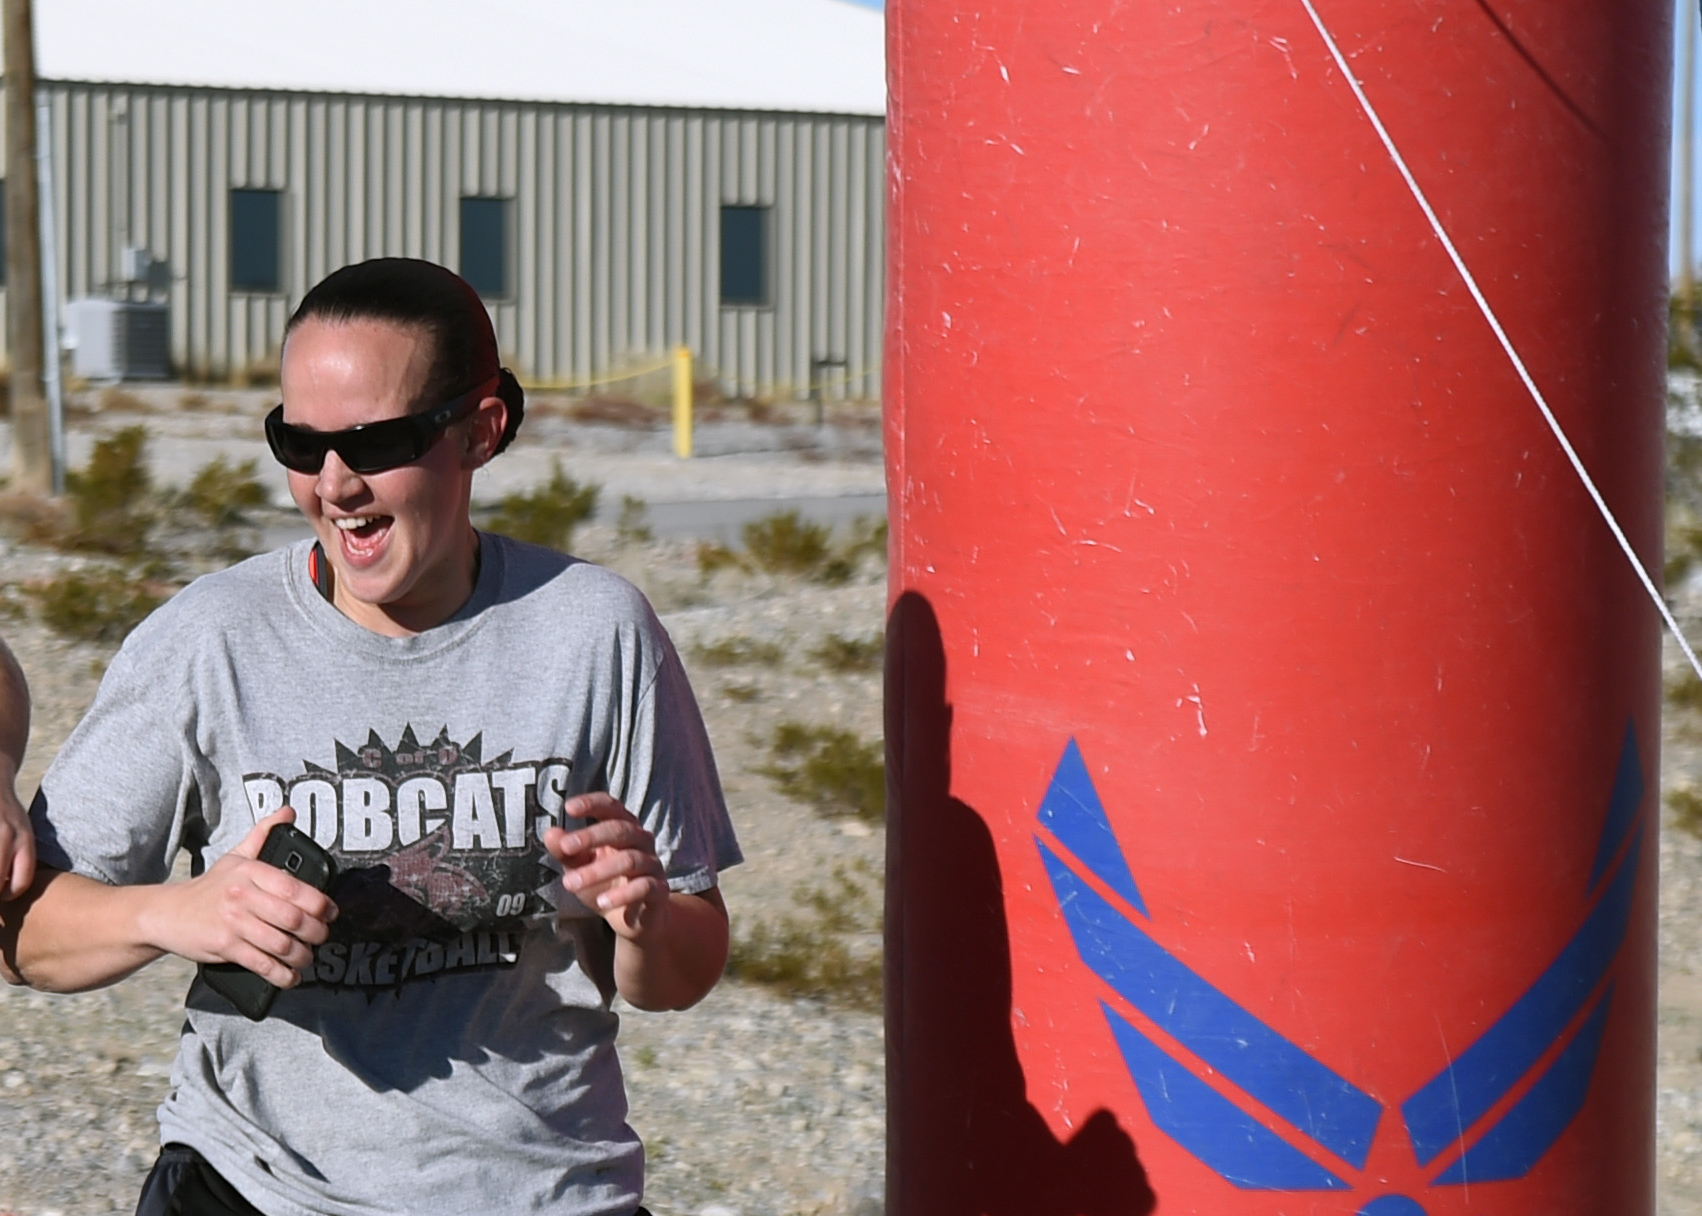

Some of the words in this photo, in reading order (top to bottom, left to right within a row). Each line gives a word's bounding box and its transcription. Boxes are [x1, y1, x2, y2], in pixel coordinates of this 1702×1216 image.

[362, 748, 381, 768] C
[244, 764, 569, 852] BOBCATS
[496, 893, 526, 917] 09
